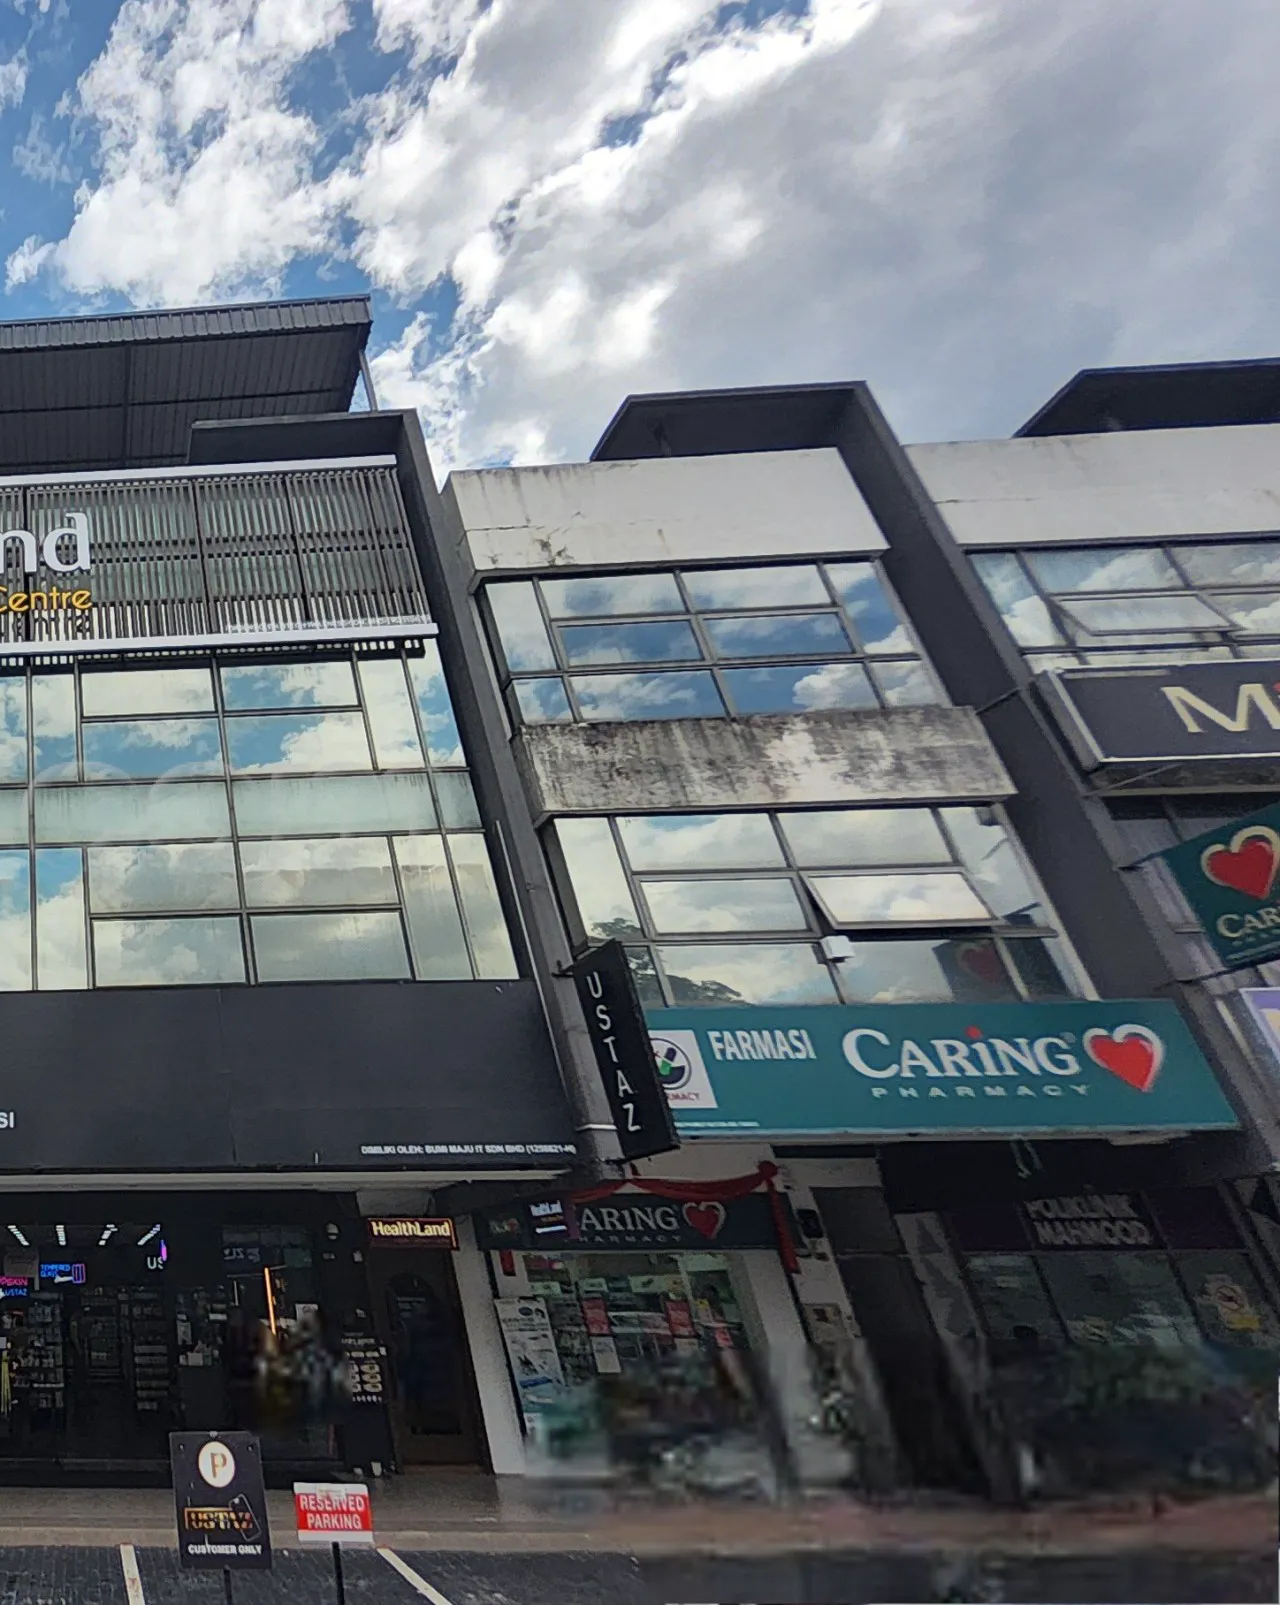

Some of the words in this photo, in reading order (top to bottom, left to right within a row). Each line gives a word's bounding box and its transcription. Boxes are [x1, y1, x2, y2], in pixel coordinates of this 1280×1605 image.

[1215, 903, 1280, 938] CAR
[585, 970, 641, 1132] USTAZ
[706, 1028, 817, 1061] FARMASI
[841, 1026, 1082, 1079] CARING
[871, 1082, 1090, 1099] PHARMACY
[370, 1220, 451, 1237] HealthLand
[579, 1205, 680, 1232] ARING
[579, 1234, 681, 1243] HARMACY
[210, 1452, 227, 1479] P
[299, 1494, 365, 1512] RESERVED
[307, 1513, 363, 1530] PARKING
[187, 1543, 237, 1554] CUSTOMER
[238, 1544, 263, 1555] ONLY
